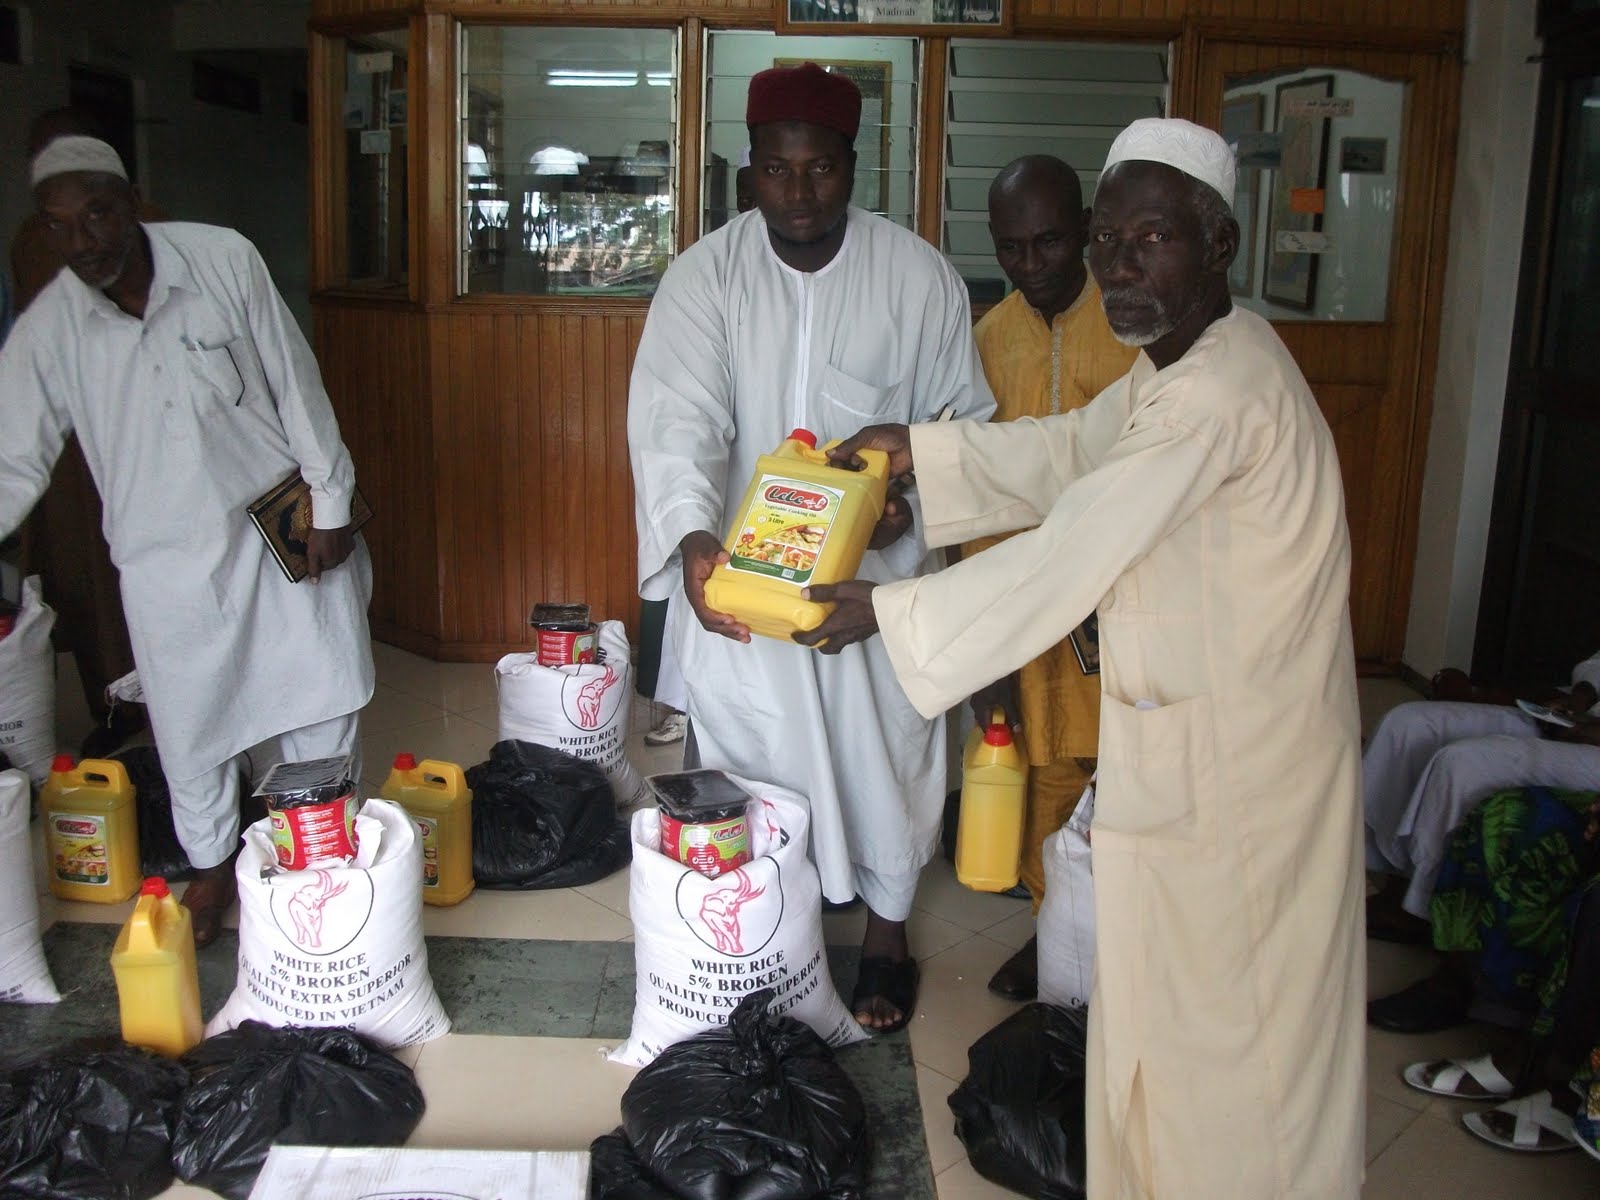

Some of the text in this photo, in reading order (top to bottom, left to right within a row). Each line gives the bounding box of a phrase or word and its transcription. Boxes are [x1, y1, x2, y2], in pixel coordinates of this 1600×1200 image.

[876, 6, 915, 17] Madinah
[559, 725, 618, 746] WHITE RICE
[575, 735, 619, 757] BROKEN
[273, 949, 367, 973] WHITE RICE
[691, 949, 785, 975] WHITE RICE
[241, 953, 411, 1005] QUALITY EXTRA SUPERIOR
[270, 964, 370, 989] 5% BROKEN
[688, 963, 788, 992] 5% BROKEN
[247, 977, 404, 1022] PRODUCED IN VIETNAM
[649, 972, 708, 1005] QUALITY
[712, 995, 744, 1008] EXT
[658, 995, 728, 1025] PRODUCE
